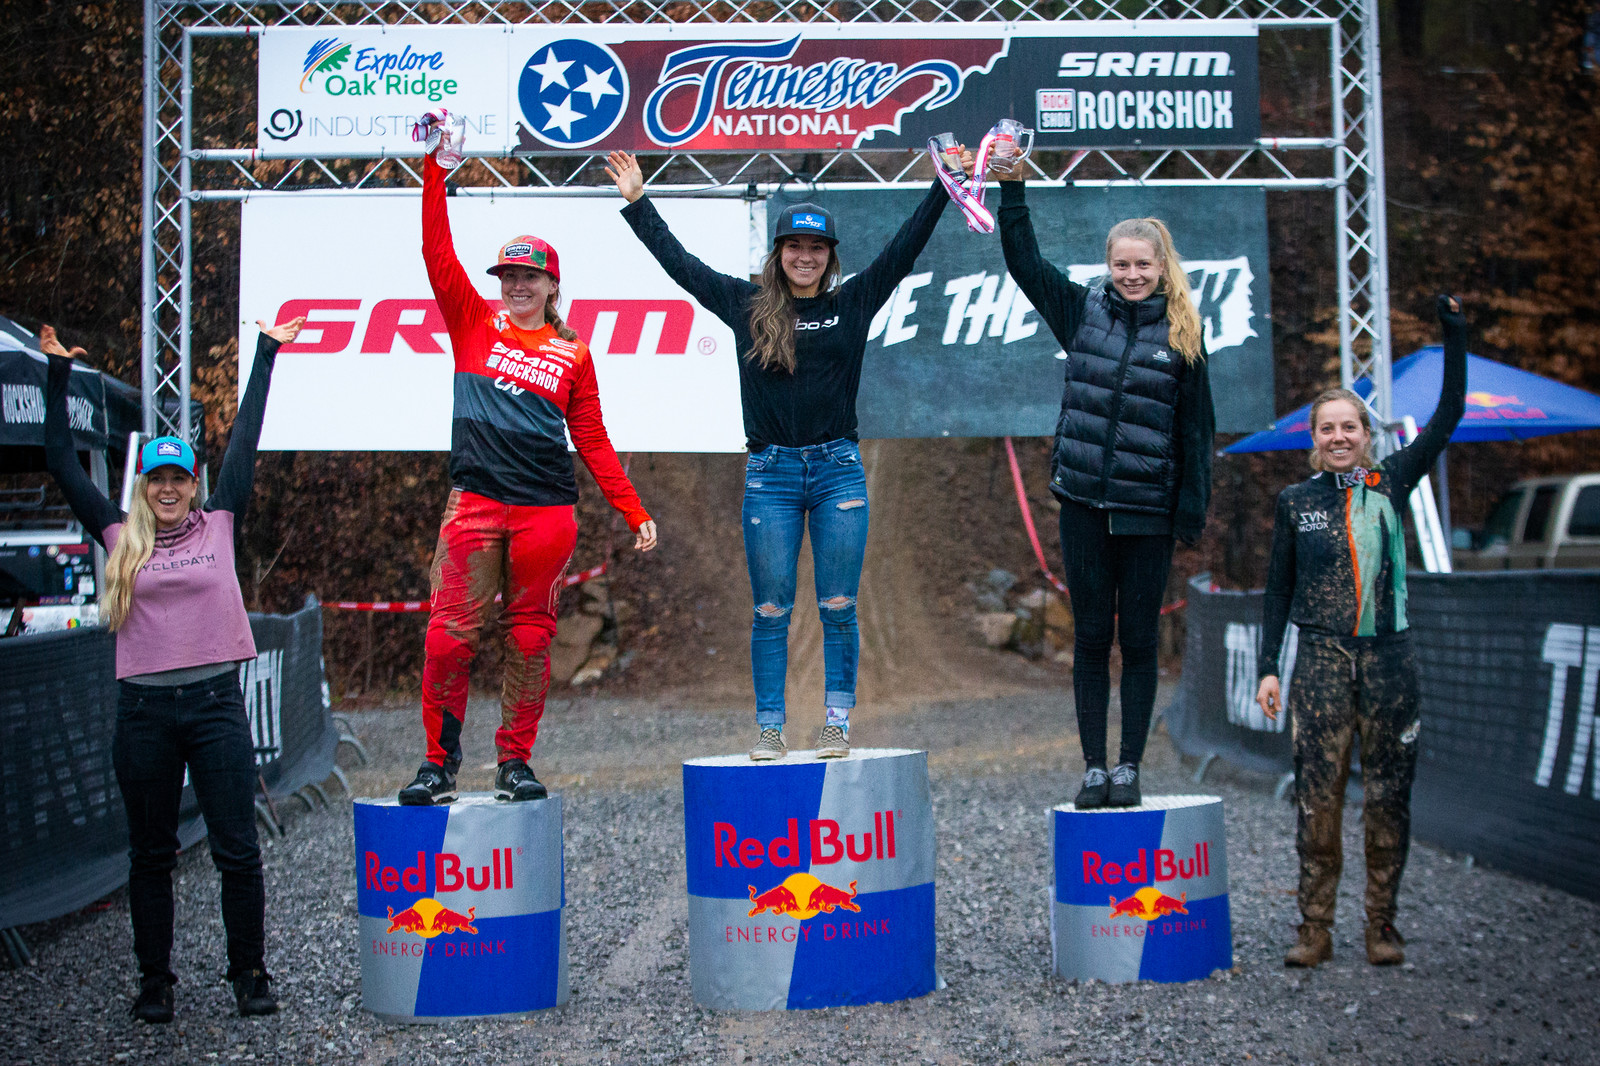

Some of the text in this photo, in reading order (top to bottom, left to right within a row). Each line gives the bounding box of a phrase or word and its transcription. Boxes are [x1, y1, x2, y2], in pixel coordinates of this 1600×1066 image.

[354, 44, 445, 80] Explore
[1057, 51, 1231, 77] SRAM
[325, 72, 458, 102] Oak Ridge
[643, 33, 964, 147] Tennessee
[713, 114, 858, 136] NATIONAL
[1077, 90, 1234, 130] ROCKSHOX
[275, 299, 695, 354] SRM
[491, 341, 564, 378] SRAM
[498, 357, 560, 394] ROCKSHOX
[2, 384, 47, 424] ROCKSHO
[141, 553, 216, 572] YCLEPATH
[714, 810, 896, 869] Red Bull
[365, 848, 514, 893] Red Bull
[1082, 842, 1210, 885] Red Bull
[726, 918, 891, 942] ENERGY DRINK
[1092, 918, 1208, 938] ENERGY DRINK
[372, 940, 507, 957] ENERGY DRINK
